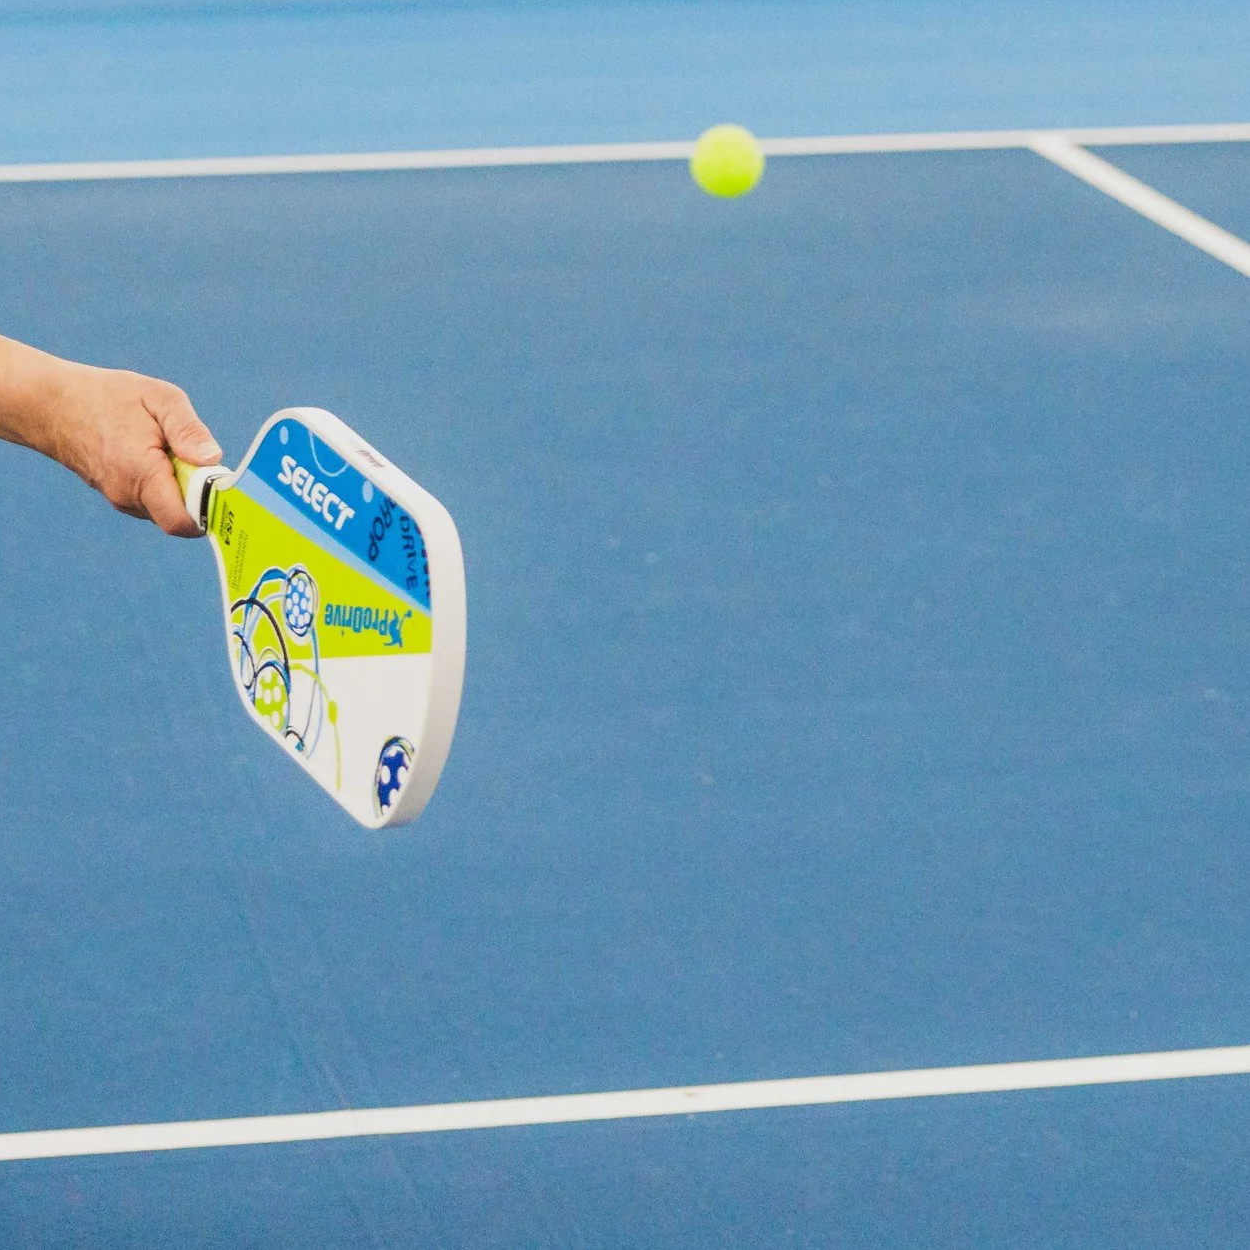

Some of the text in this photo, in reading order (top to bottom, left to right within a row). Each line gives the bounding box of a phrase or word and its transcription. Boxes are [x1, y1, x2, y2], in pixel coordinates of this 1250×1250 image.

[277, 455, 355, 530] SELECT
[399, 515, 419, 590] DRIVE
[324, 603, 390, 638] ProDrive
